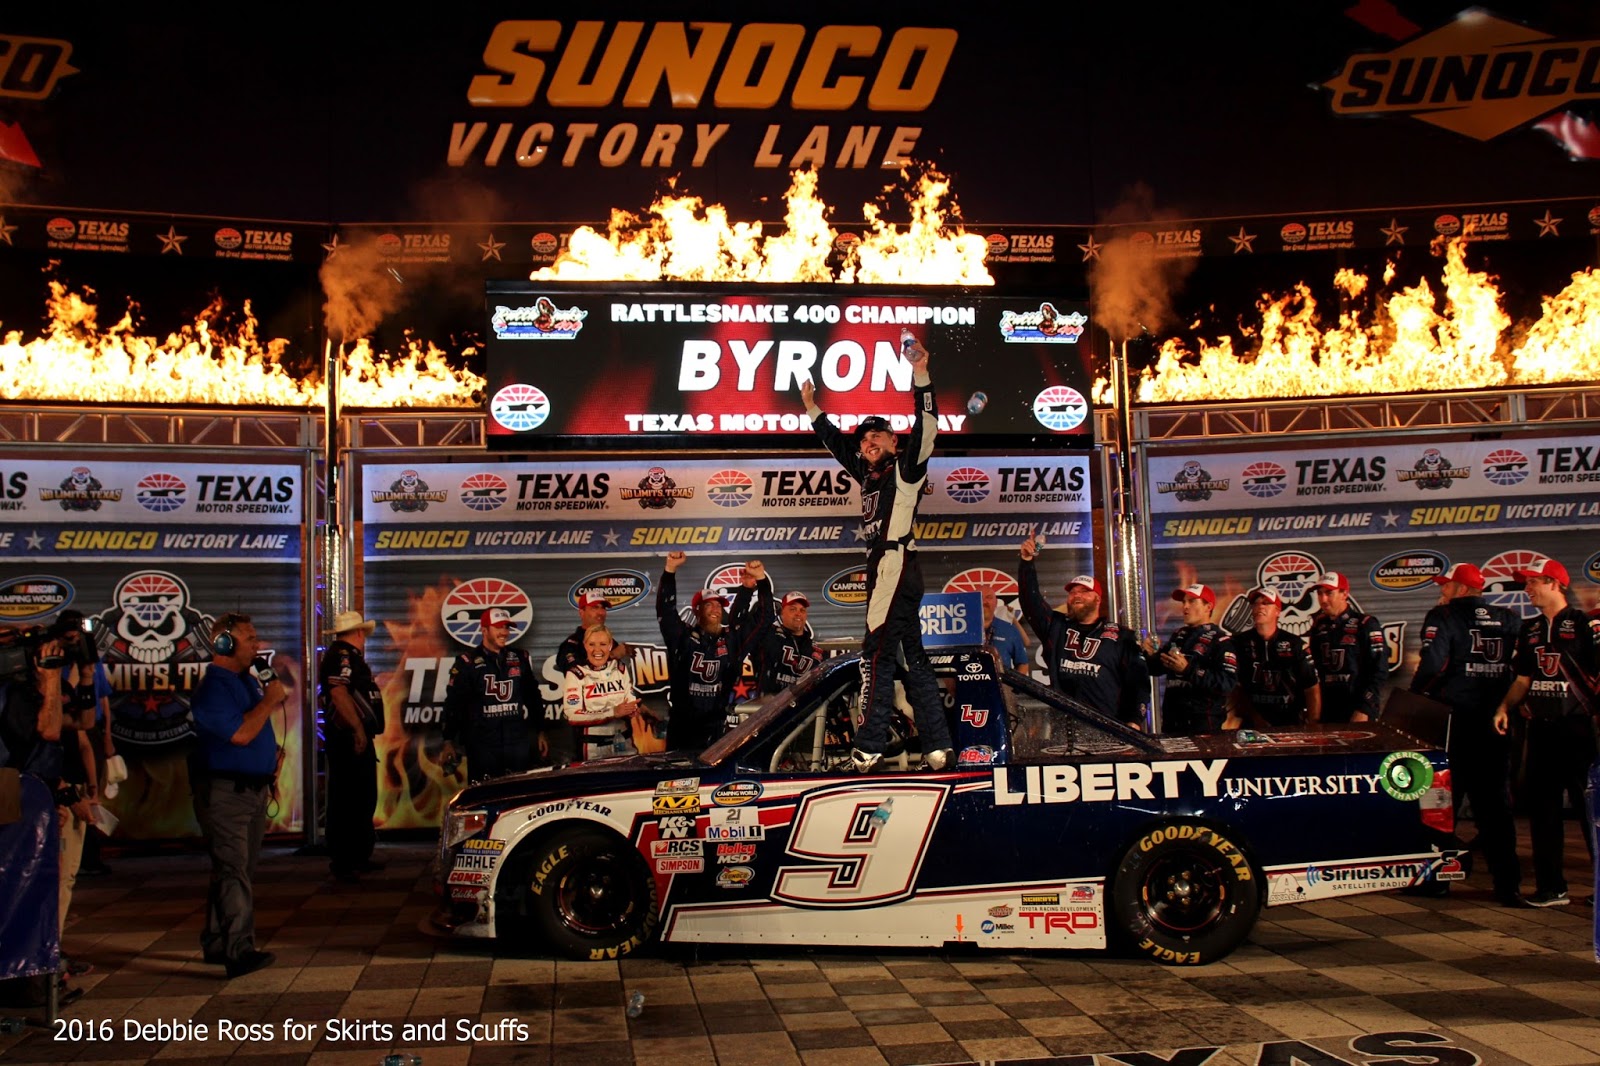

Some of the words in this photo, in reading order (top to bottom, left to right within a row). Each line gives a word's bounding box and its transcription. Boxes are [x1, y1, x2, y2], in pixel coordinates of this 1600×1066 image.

[467, 20, 958, 111] SUNOCO
[447, 122, 730, 168] VICTORY
[754, 124, 922, 169] LANE
[78, 220, 130, 237] TEXAS
[1308, 220, 1354, 236] TEXAS
[244, 230, 293, 246] TEXAS
[404, 234, 450, 247] TEXAS
[1010, 235, 1054, 248] TEXAS
[610, 304, 788, 323] RATTLESNAKE
[793, 305, 841, 324] 400
[845, 306, 975, 325] CHAMPION
[677, 340, 913, 393] BYRON
[624, 414, 714, 431] TEXAS
[719, 414, 813, 432] MOTOR
[1295, 456, 1386, 485] TEXAS
[1441, 466, 1471, 479] TEXAS
[516, 472, 610, 499] TEXAS
[761, 470, 852, 496] TEXAS
[998, 467, 1084, 492] TEXAS
[1201, 478, 1230, 491] TEXAS
[1538, 474, 1573, 484] MOTOR
[90, 487, 123, 501] TEXAS
[195, 475, 294, 501] TEXAS
[416, 489, 448, 502] TEXAS
[665, 487, 695, 499] TEXAS
[1296, 486, 1330, 496] MOTOR
[1333, 483, 1384, 494] SPEEDWAY
[516, 501, 551, 511] MOTOR
[554, 501, 606, 510] SPEEDWAY
[762, 498, 796, 507] MOTOR
[798, 497, 850, 506] SPEEDWAY
[999, 494, 1032, 503] MOTOR
[1034, 493, 1082, 502] SPEEDWAY
[195, 504, 233, 513] MOTOR
[236, 505, 290, 514] SPEEDWAY
[1409, 504, 1501, 525] SUNOCO
[1505, 503, 1576, 519] VICTORY
[972, 522, 1038, 537] VICTORY
[1041, 521, 1082, 536] LANE
[1162, 517, 1253, 537] SUNOCO
[1258, 514, 1327, 531] VICTORY
[1328, 513, 1372, 528] LANE
[55, 530, 159, 549] SUNOCO
[163, 533, 240, 549] VICTORY
[240, 534, 288, 549] LANE
[375, 530, 470, 549] SUNOCO
[474, 531, 544, 546] VICTORY
[548, 530, 593, 545] LANE
[630, 526, 723, 545] SUNOCO
[727, 527, 797, 542] VICTORY
[798, 526, 843, 540] LANE
[1378, 567, 1412, 576] CAMPING
[1414, 566, 1441, 575] WORLD
[608, 578, 635, 586] NASCAR
[832, 582, 866, 590] CAMPING
[33, 595, 64, 603] WORLD
[578, 587, 613, 595] CAMPING
[613, 587, 642, 596] WORLD
[1064, 628, 1101, 660] LU
[633, 648, 669, 686] NO
[1060, 658, 1101, 674] LIBERTY
[957, 673, 991, 681] TOYOTA
[484, 674, 514, 702] LU
[585, 679, 625, 699] ZMAX
[483, 703, 519, 714] LIBERTY
[961, 704, 989, 728] LU
[1384, 752, 1431, 769] AMERICAN
[993, 759, 1229, 806] LIBERTY
[1224, 774, 1380, 797] UNIVERSITY
[1386, 784, 1430, 801] ETHANOL
[726, 809, 742, 821] 21
[708, 826, 745, 839] Mobil
[751, 826, 760, 837] 1
[464, 840, 505, 850] MOOG
[668, 840, 700, 853] RCS
[717, 843, 756, 856] Holley
[769, 782, 951, 907] 9
[717, 855, 751, 864] MSD
[1139, 825, 1251, 882] GOODYEAR
[456, 855, 496, 869] MAHLE
[531, 845, 569, 895] EAGLE
[660, 859, 700, 871] SIMPSON
[450, 872, 482, 882] COMP
[1019, 912, 1097, 934] TRD
[1138, 938, 1200, 964] EAGLE
